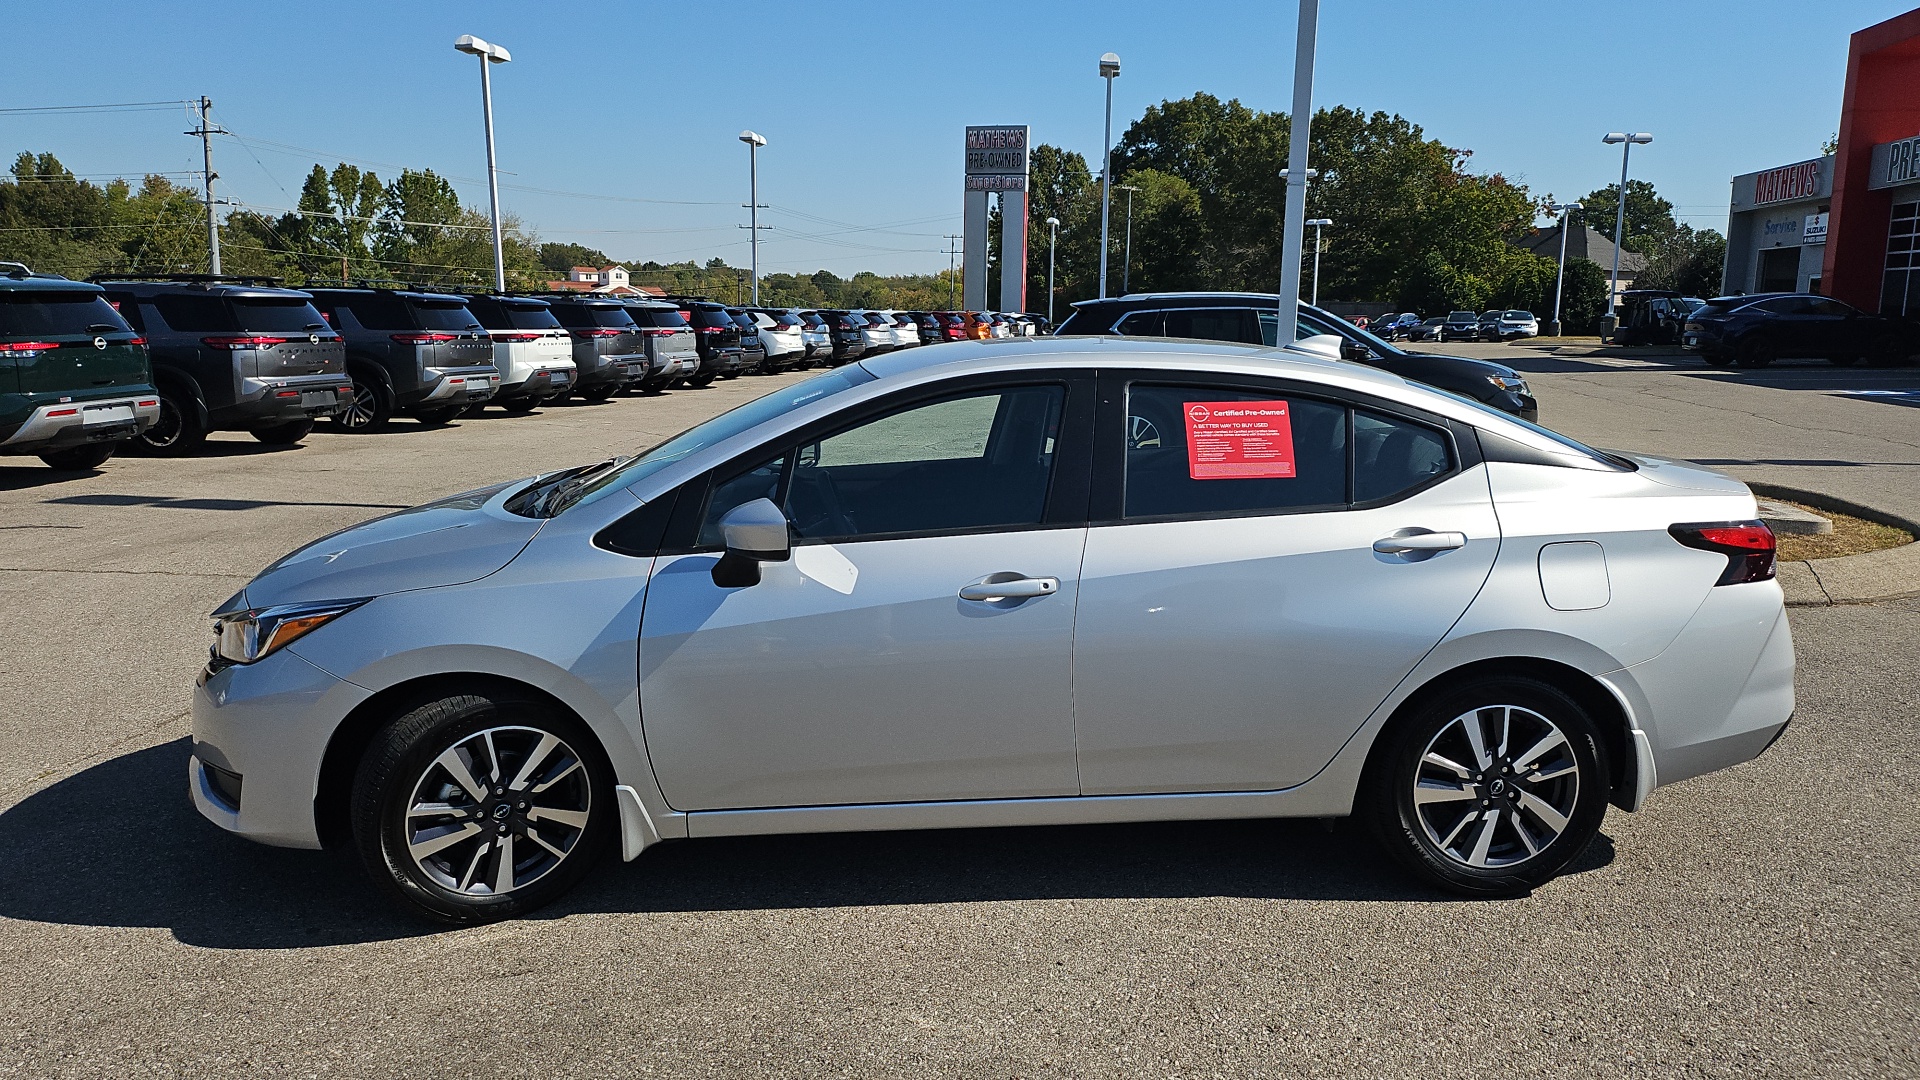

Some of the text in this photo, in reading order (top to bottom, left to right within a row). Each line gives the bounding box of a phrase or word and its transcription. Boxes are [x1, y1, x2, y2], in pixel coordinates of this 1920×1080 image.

[968, 130, 1024, 149] MATHEWS
[968, 152, 1022, 168] PRE-OWNED
[966, 175, 1024, 190] SuperStore
[1754, 161, 1817, 206] MATHEWS
[1764, 217, 1796, 235] Service
[1806, 226, 1826, 235] SUZUKI
